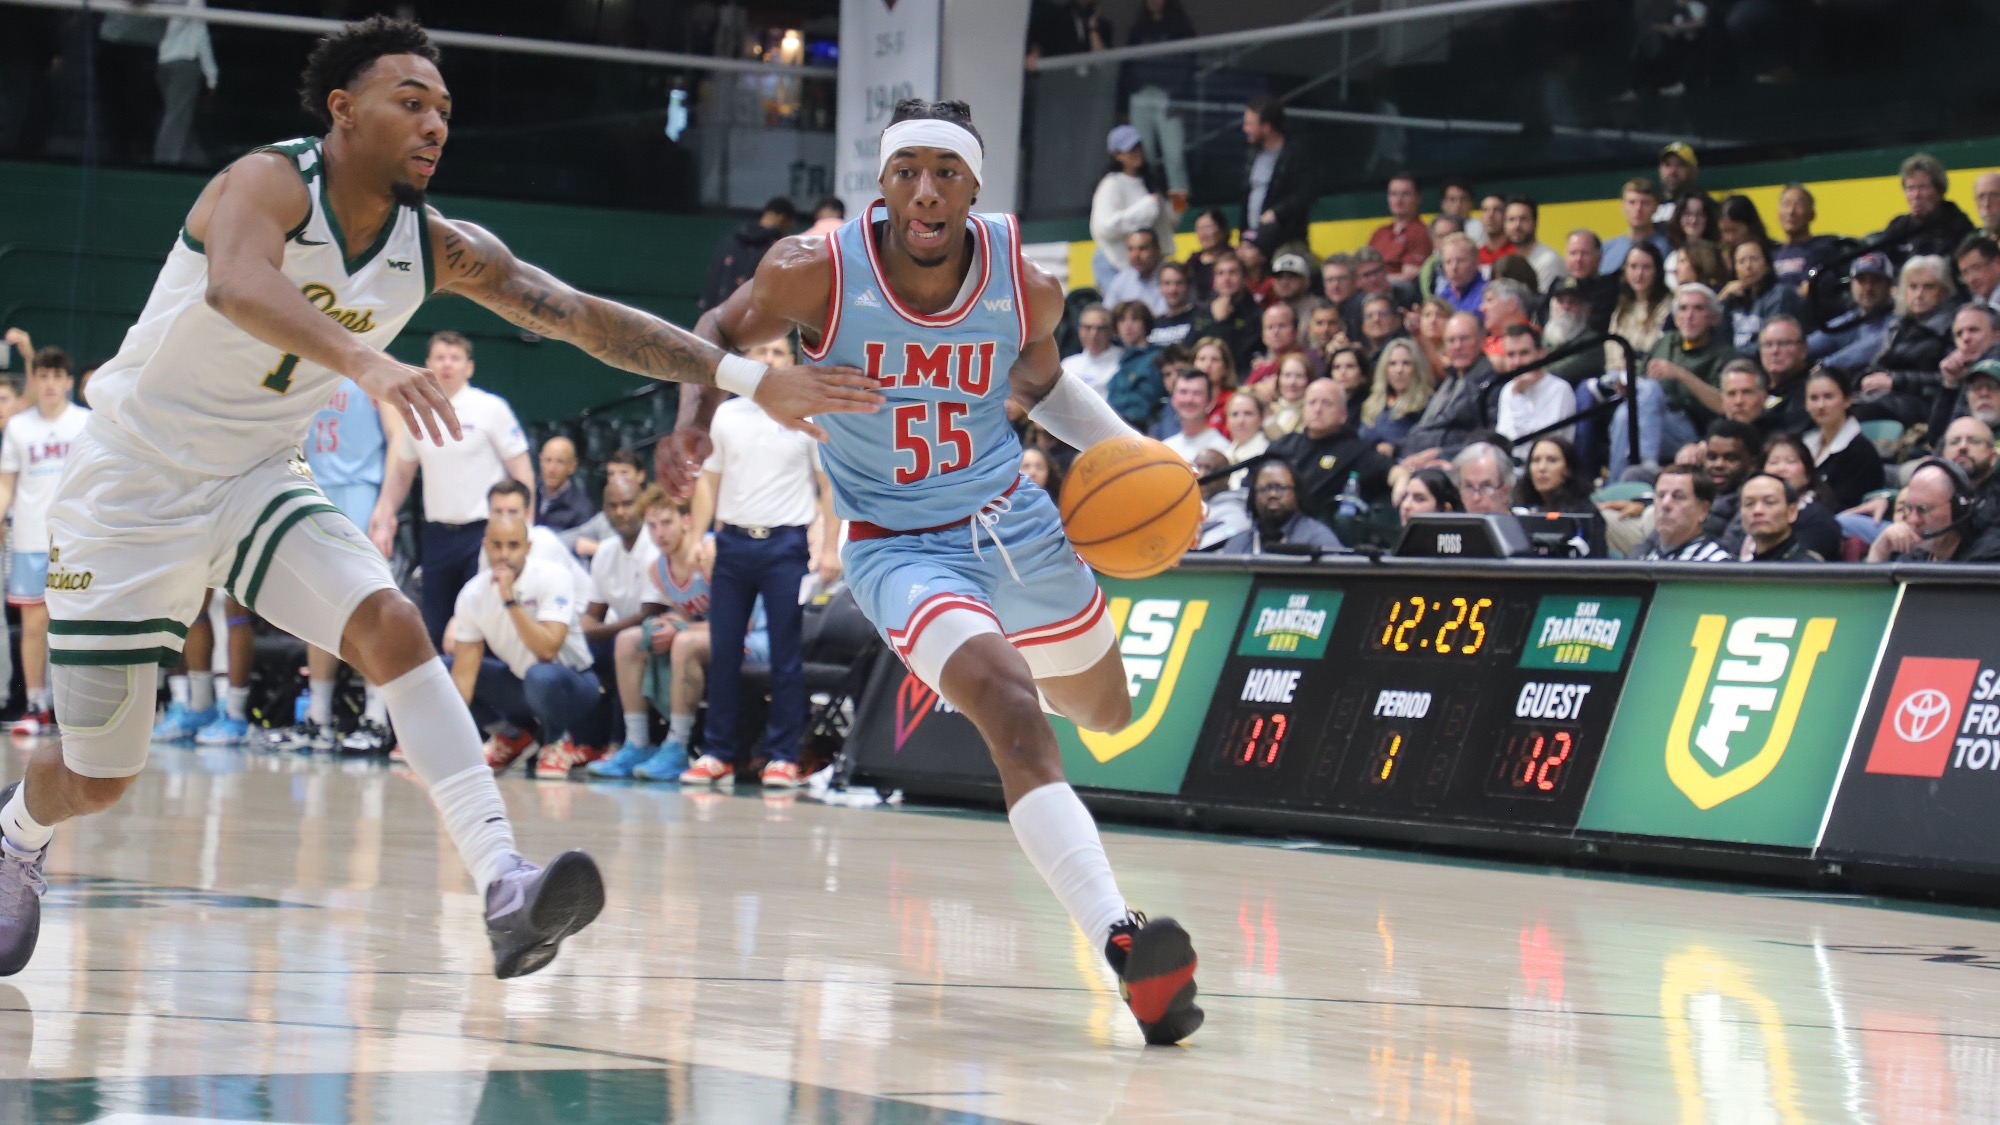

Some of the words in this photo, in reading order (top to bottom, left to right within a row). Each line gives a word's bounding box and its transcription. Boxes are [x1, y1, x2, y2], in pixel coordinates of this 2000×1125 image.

[863, 341, 997, 399] LMU
[315, 420, 338, 453] 15
[893, 401, 973, 486] 55
[1436, 533, 1462, 554] POSS
[1254, 607, 1328, 640] FRANCISCO
[1381, 596, 1493, 654] 12:25
[1575, 602, 1601, 618] SAN
[1537, 616, 1622, 651] FRANCISCO
[1240, 668, 1302, 704] HOME
[1372, 689, 1432, 719] PERIOD
[1515, 681, 1592, 720] GUEST
[1962, 703, 2000, 735] FR
[1243, 713, 1287, 764] 17
[1380, 734, 1401, 780] 1
[1523, 731, 1572, 791] 12
